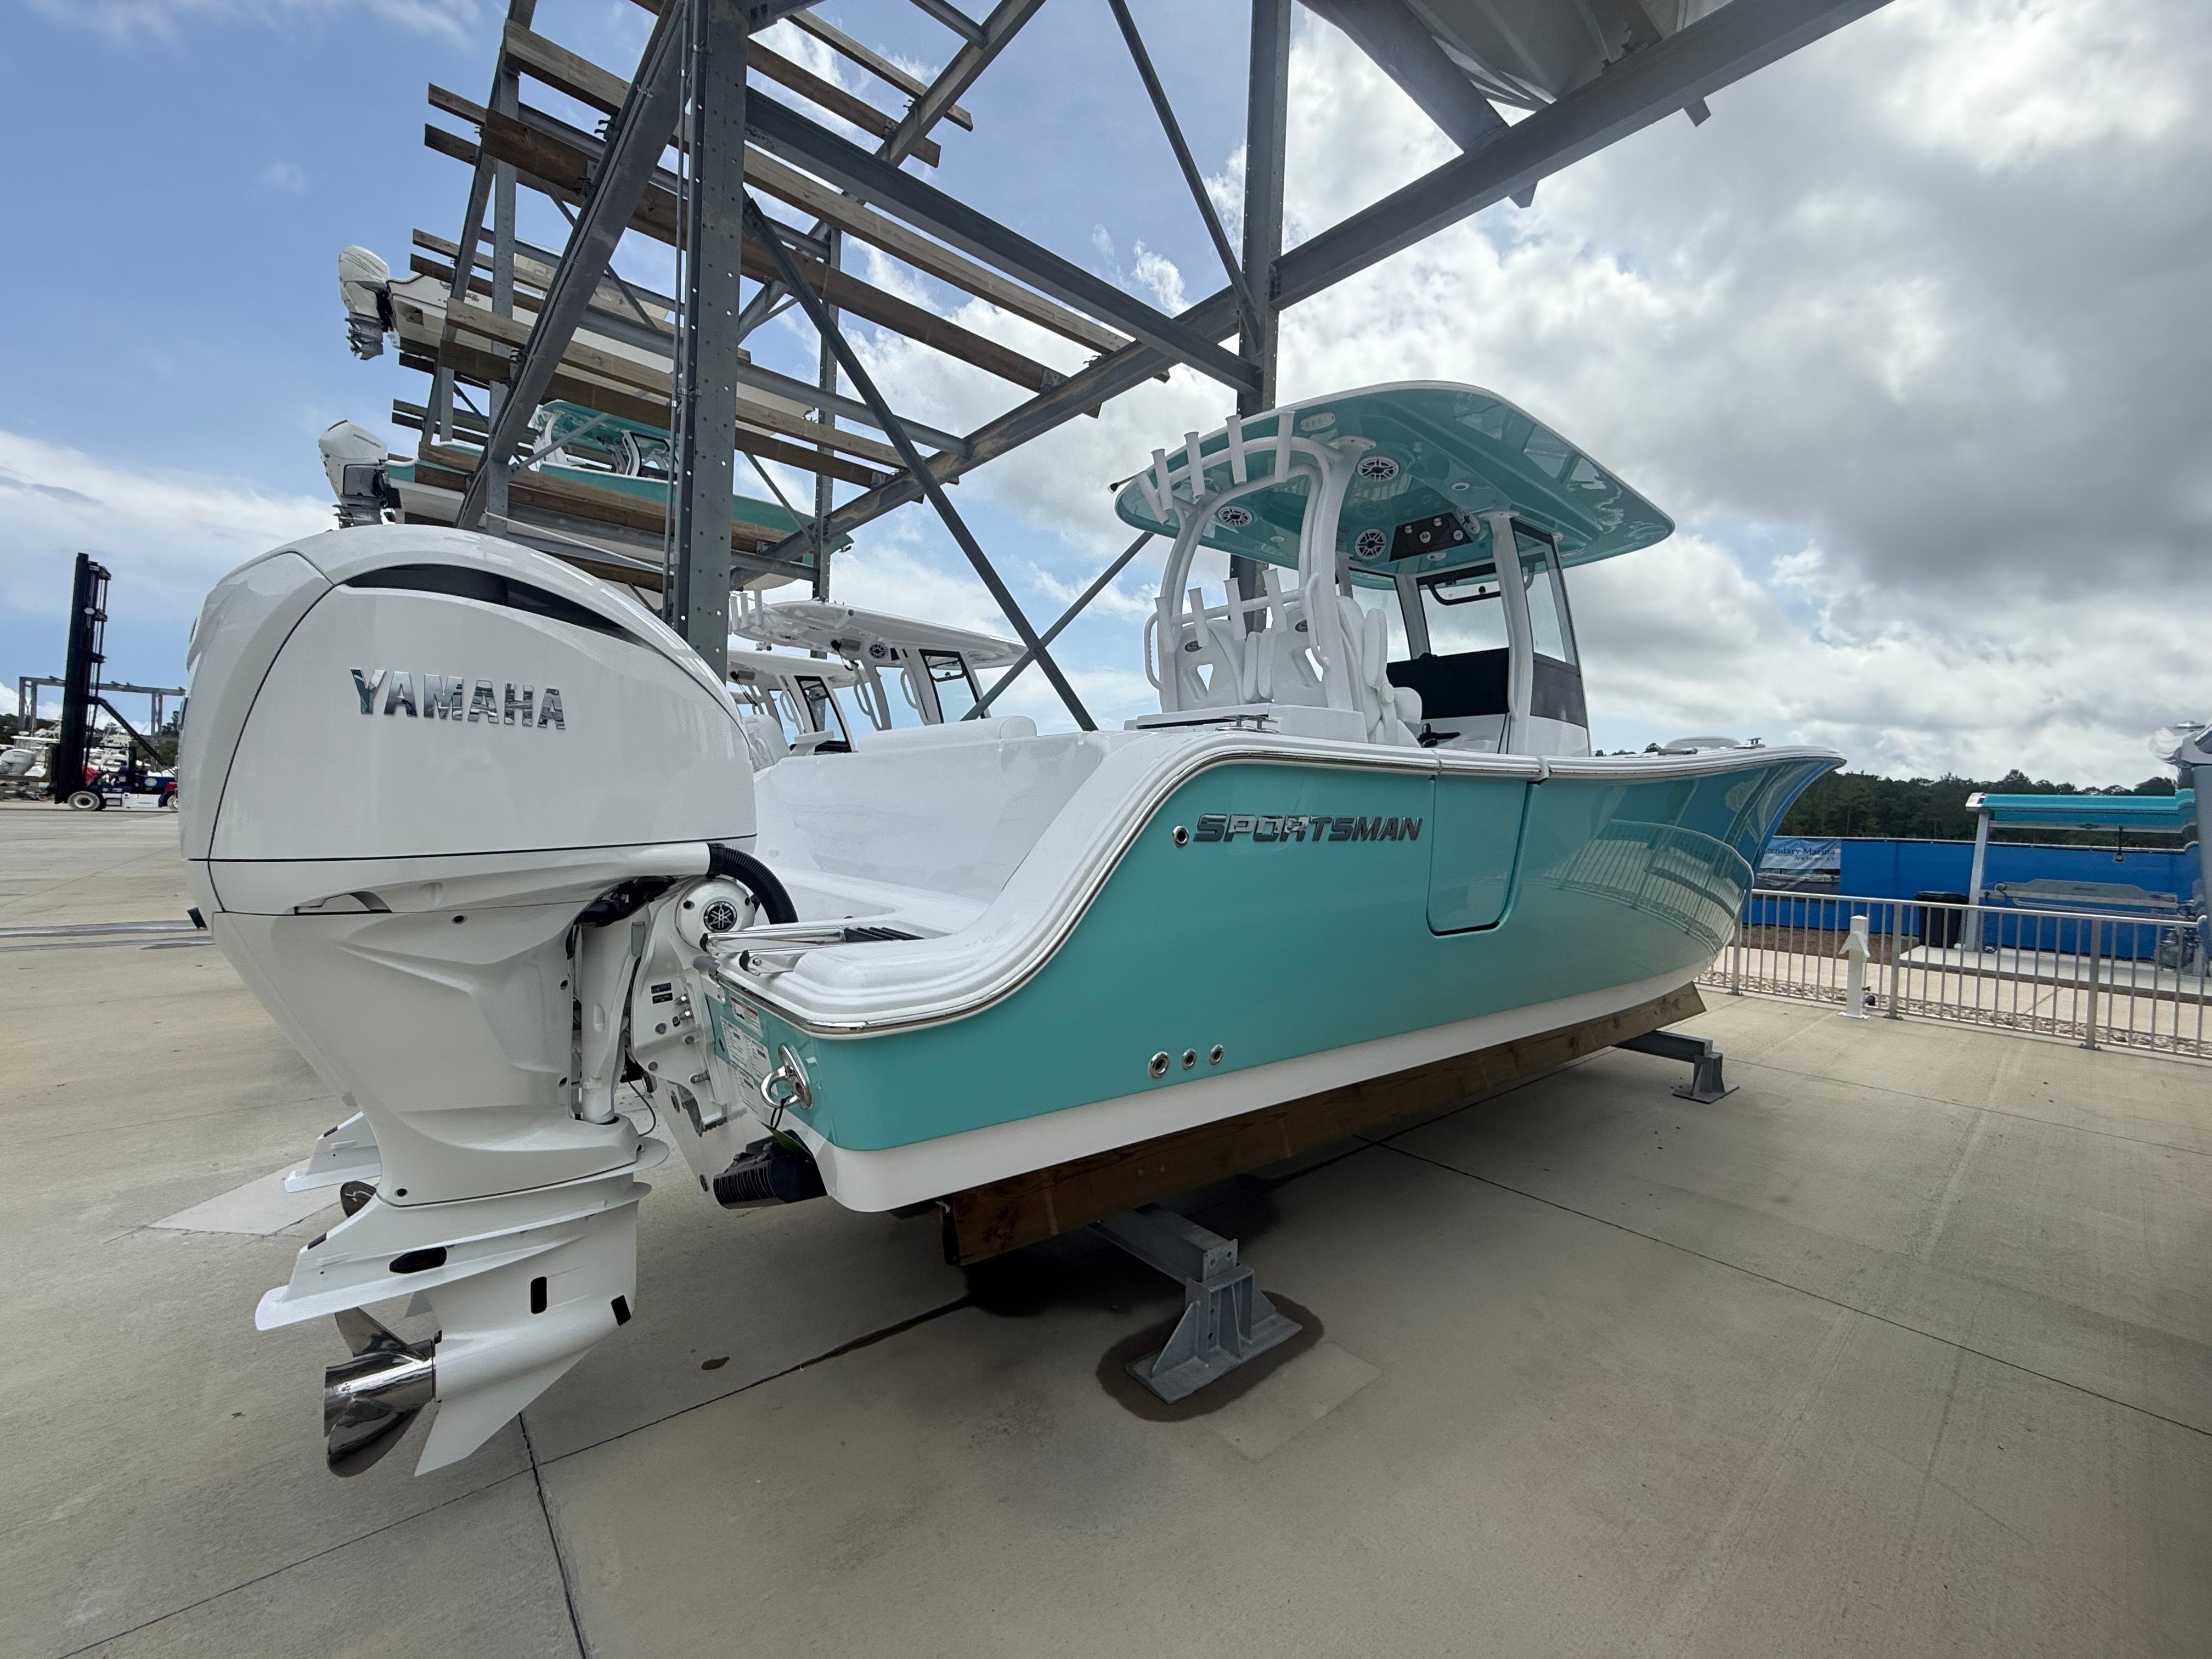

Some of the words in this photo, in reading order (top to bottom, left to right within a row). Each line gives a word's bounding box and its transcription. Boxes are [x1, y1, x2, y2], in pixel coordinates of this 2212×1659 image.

[350, 667, 566, 730] YAMAHA
[1193, 813, 1423, 842] SPORTSMAN
[1765, 848, 1801, 856] gendary
